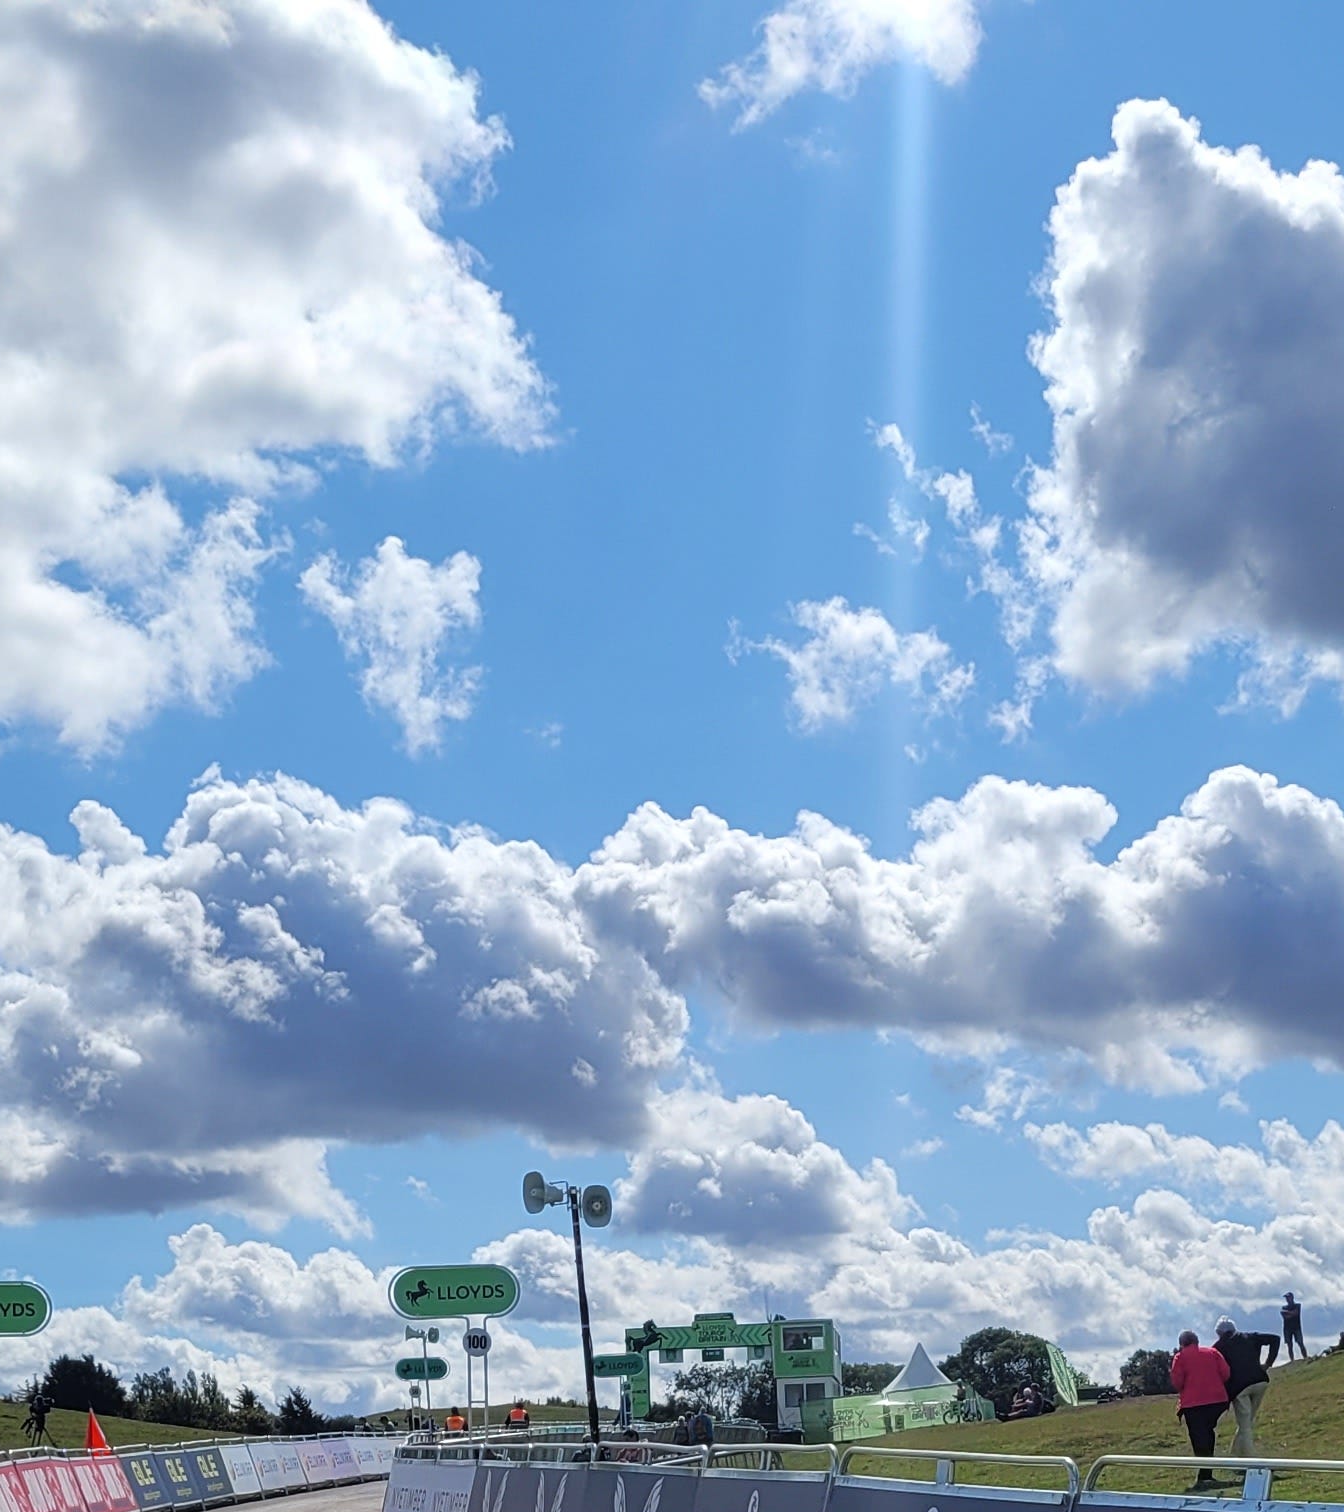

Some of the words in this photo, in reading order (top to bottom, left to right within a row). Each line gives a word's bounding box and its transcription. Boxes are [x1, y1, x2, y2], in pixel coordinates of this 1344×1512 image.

[437, 1284, 505, 1300] LLOYDS
[467, 1334, 488, 1350] 100
[414, 1364, 443, 1373] LLYDS
